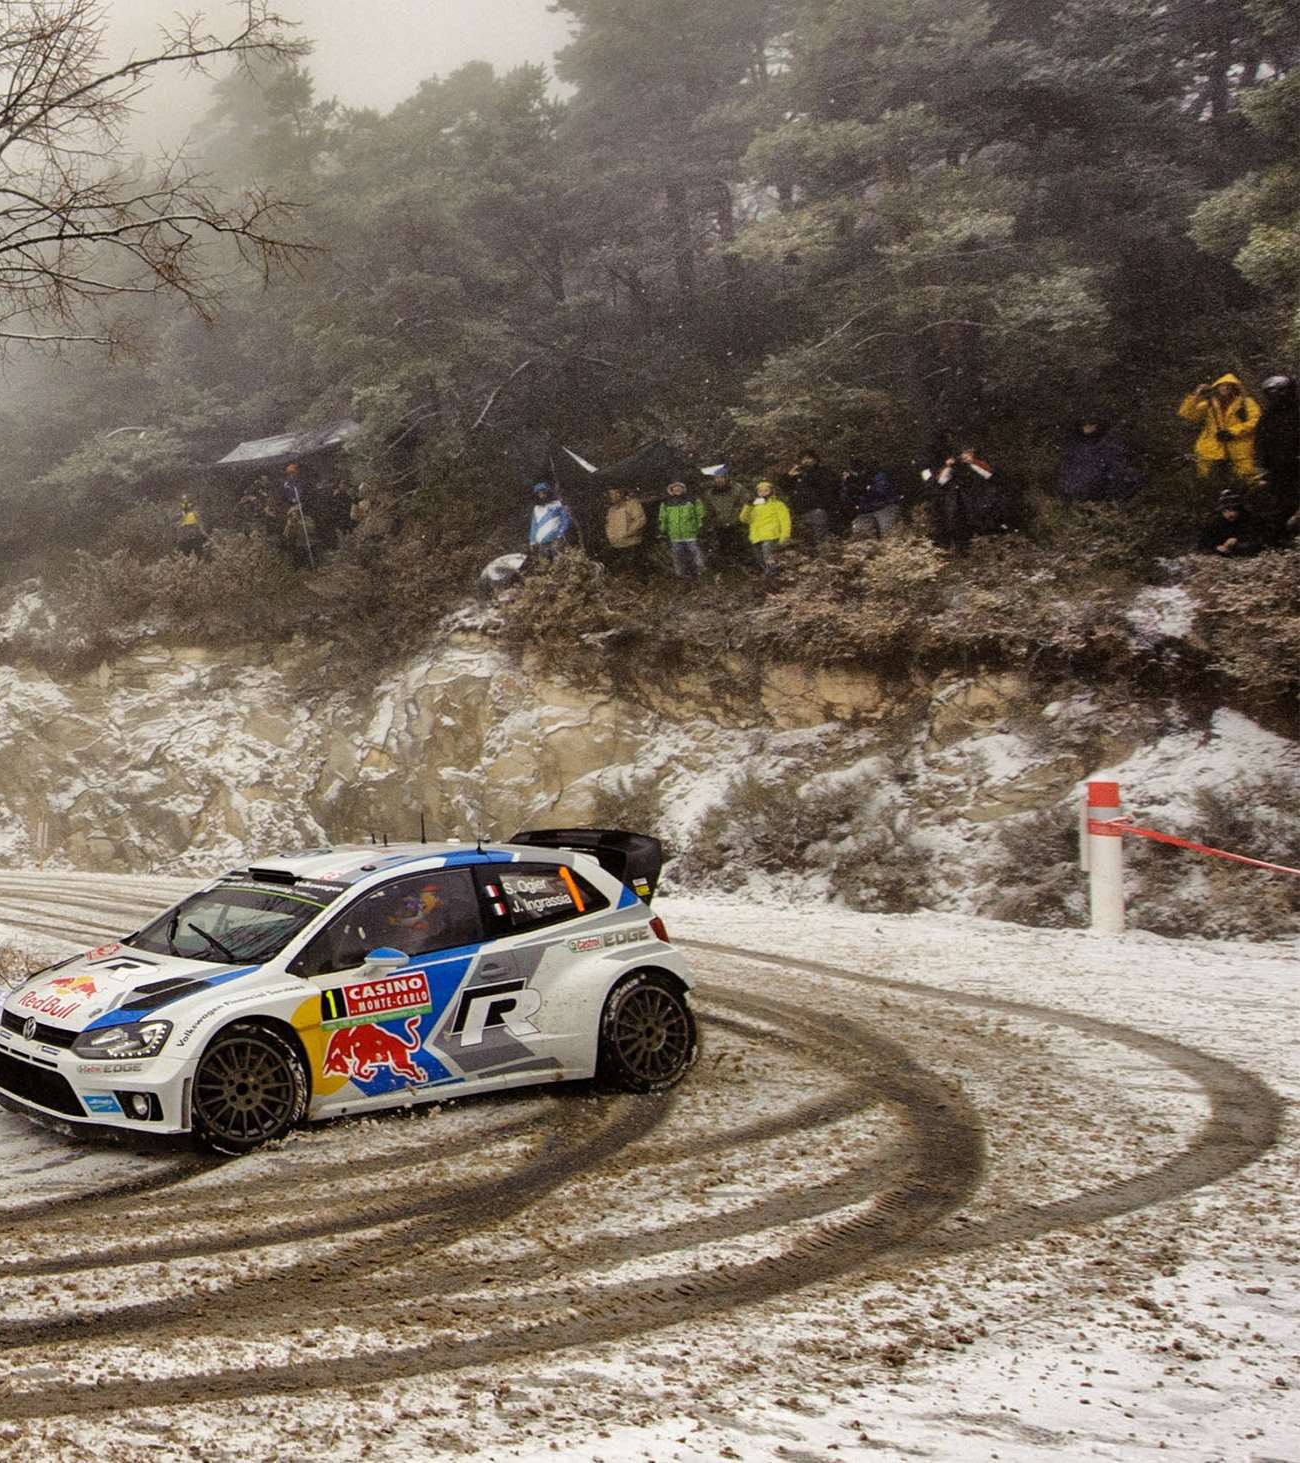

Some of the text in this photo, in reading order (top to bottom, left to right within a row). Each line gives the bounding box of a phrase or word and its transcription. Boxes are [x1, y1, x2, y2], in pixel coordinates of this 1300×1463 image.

[502, 879, 547, 895] S. Ogier
[513, 893, 573, 913] J. Ingrassia
[603, 926, 650, 948] EDGE
[349, 977, 423, 1000] CASINO
[326, 990, 337, 1018] 1
[358, 991, 428, 1013] MONTE-CARLO
[176, 1004, 224, 1047] Volkswagen
[460, 987, 542, 1048] R
[103, 1063, 143, 1073] EDGE
